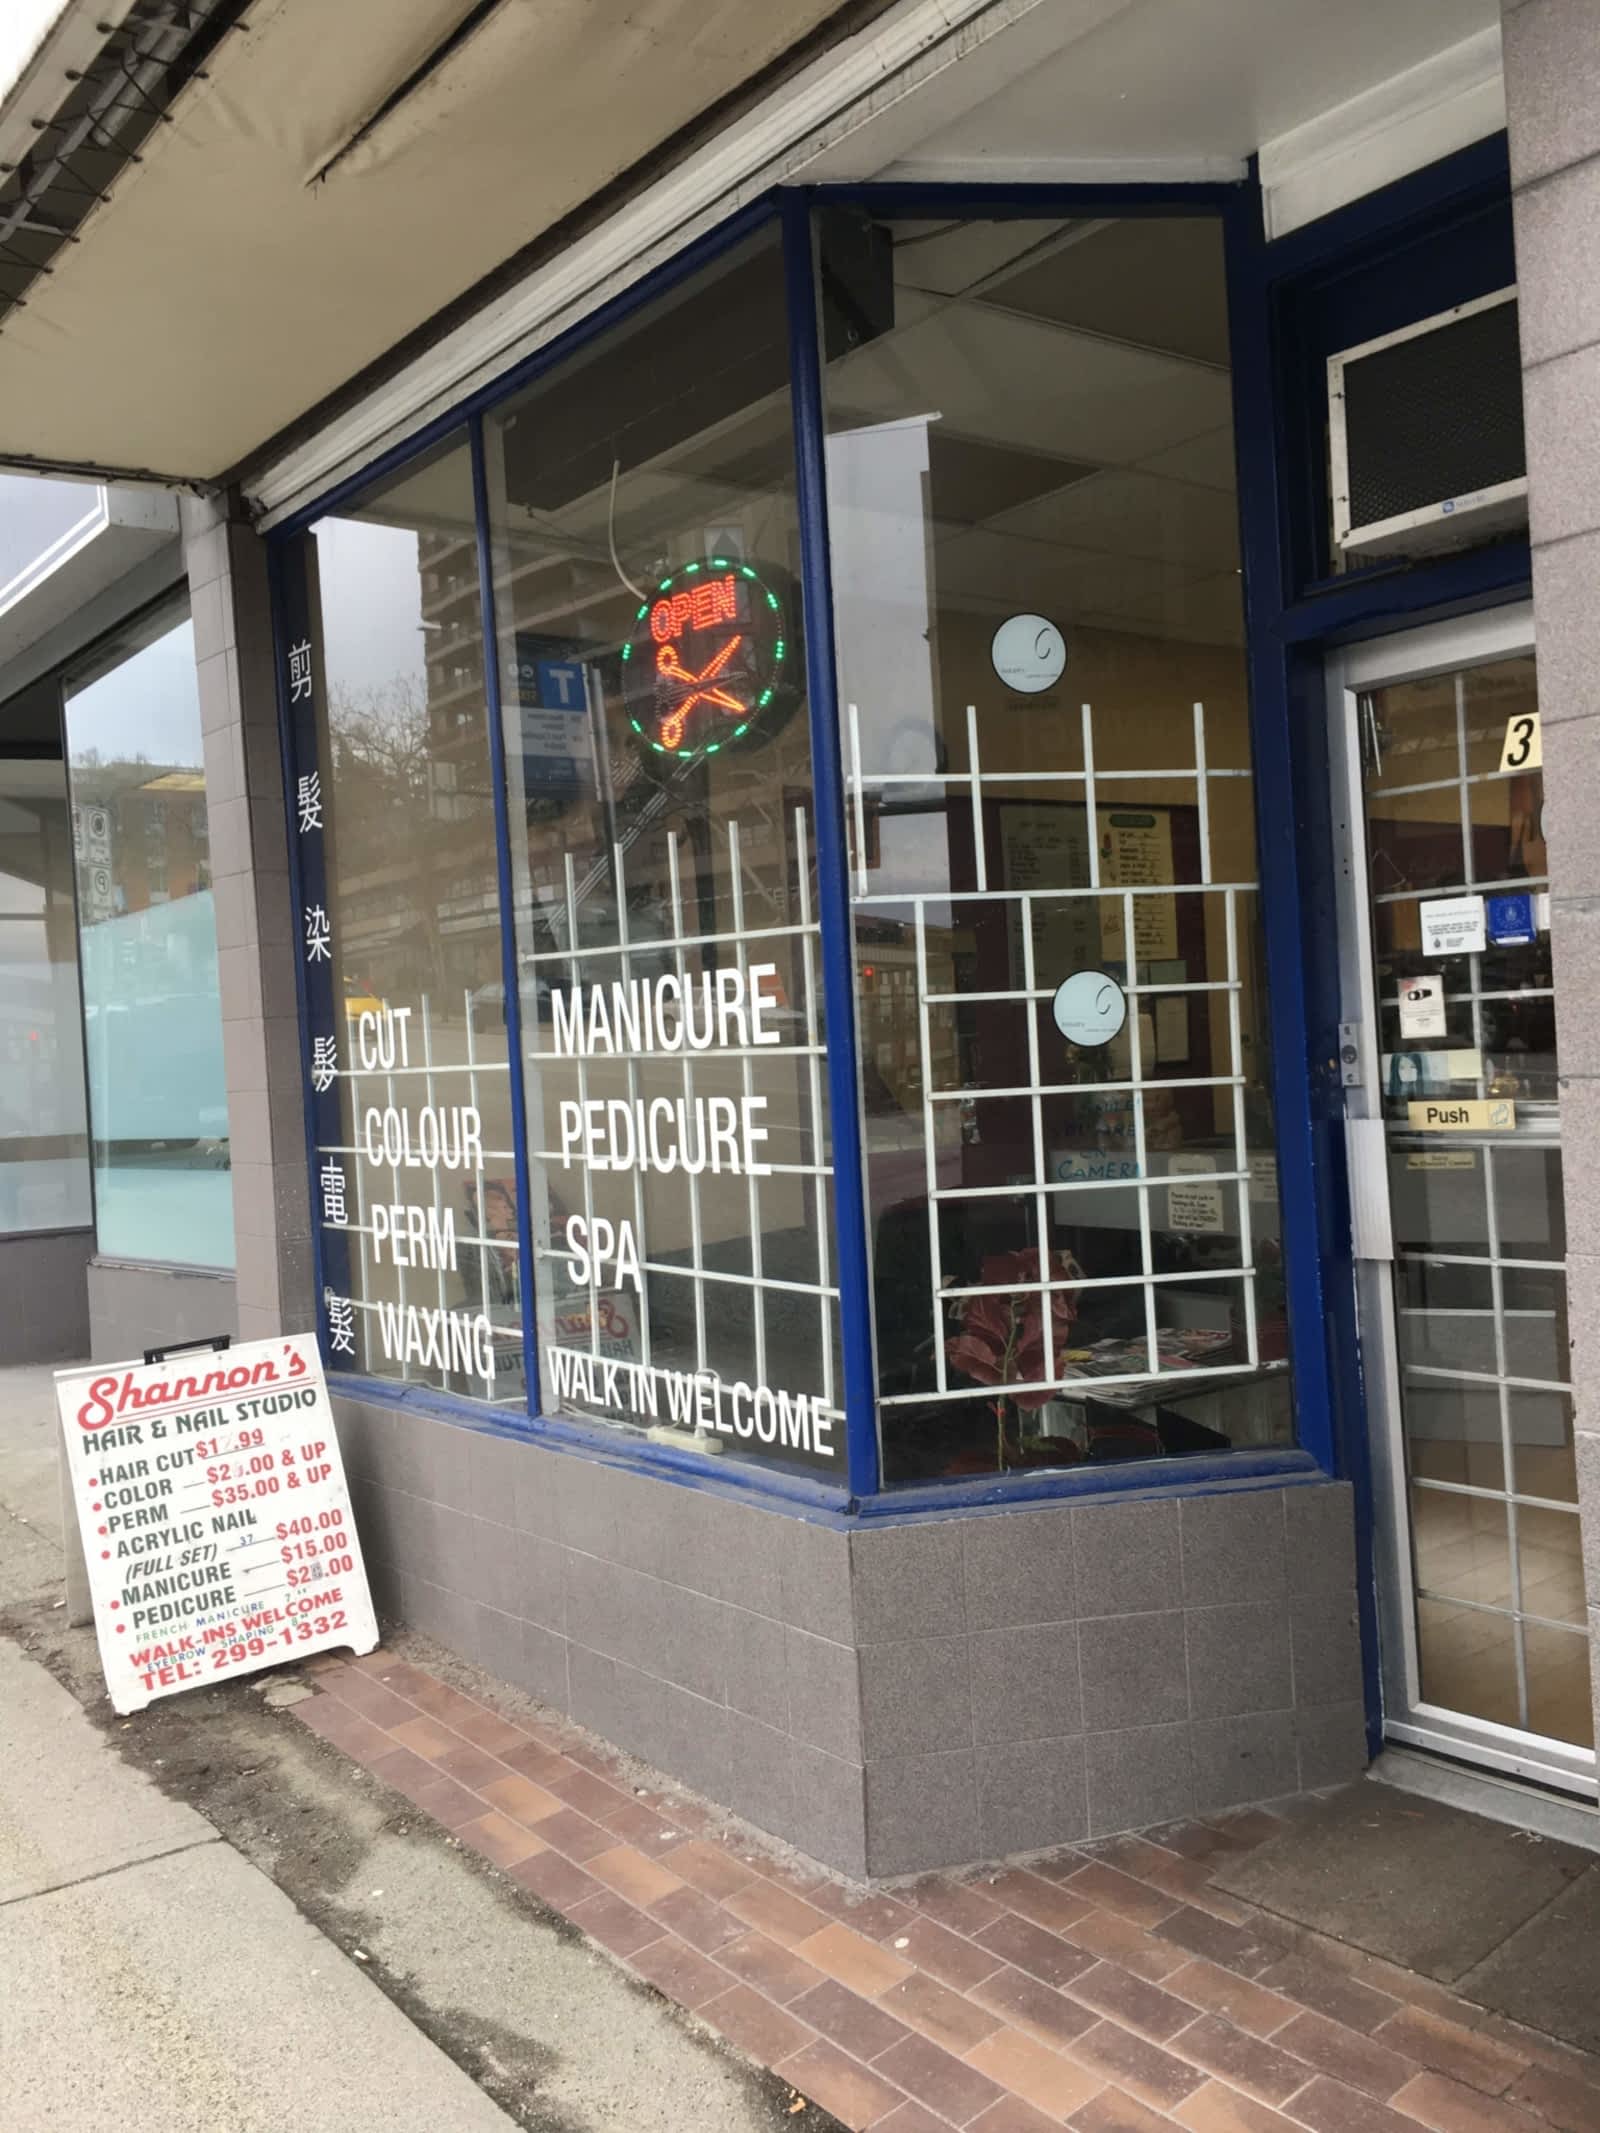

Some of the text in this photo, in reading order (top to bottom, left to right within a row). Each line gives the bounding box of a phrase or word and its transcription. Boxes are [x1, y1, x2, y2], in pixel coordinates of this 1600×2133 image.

[651, 574, 737, 642] OPEN
[359, 1008, 411, 1070] CUT
[551, 964, 780, 1055] MANICURE
[365, 1106, 484, 1169] COLOUR
[560, 1096, 772, 1176] PEDICURE
[1427, 1107, 1470, 1124] Push
[372, 1204, 457, 1271] PERM
[566, 1215, 642, 1293] SPA
[378, 1301, 496, 1380] WAXING
[77, 1345, 306, 1430] Shannon's
[83, 1389, 317, 1455] HAIR & NAIL STUDIO
[547, 1346, 835, 1457] WALK IN WELCOME
[100, 1428, 264, 1485] HAIR CUT $1.99
[104, 1478, 173, 1509] COLOR
[281, 1449, 295, 1465] &
[301, 1441, 326, 1461] UP
[108, 1463, 332, 1533] PERM $35.00 & UP
[117, 1508, 257, 1558] ACRYLIC NAIL
[122, 1531, 347, 1606] MANICURE $15.00
[125, 1554, 174, 1585] (FULL
[179, 1543, 217, 1567] SET)
[276, 1508, 342, 1540] $40.00
[129, 1588, 343, 1667] WALK-INS WELCOME
[133, 1554, 353, 1629] PEDICURE $2.00
[136, 1622, 188, 1643] FRENCH
[195, 1600, 265, 1627] MANICURE
[139, 1610, 349, 1691] TEL: 299-1332
